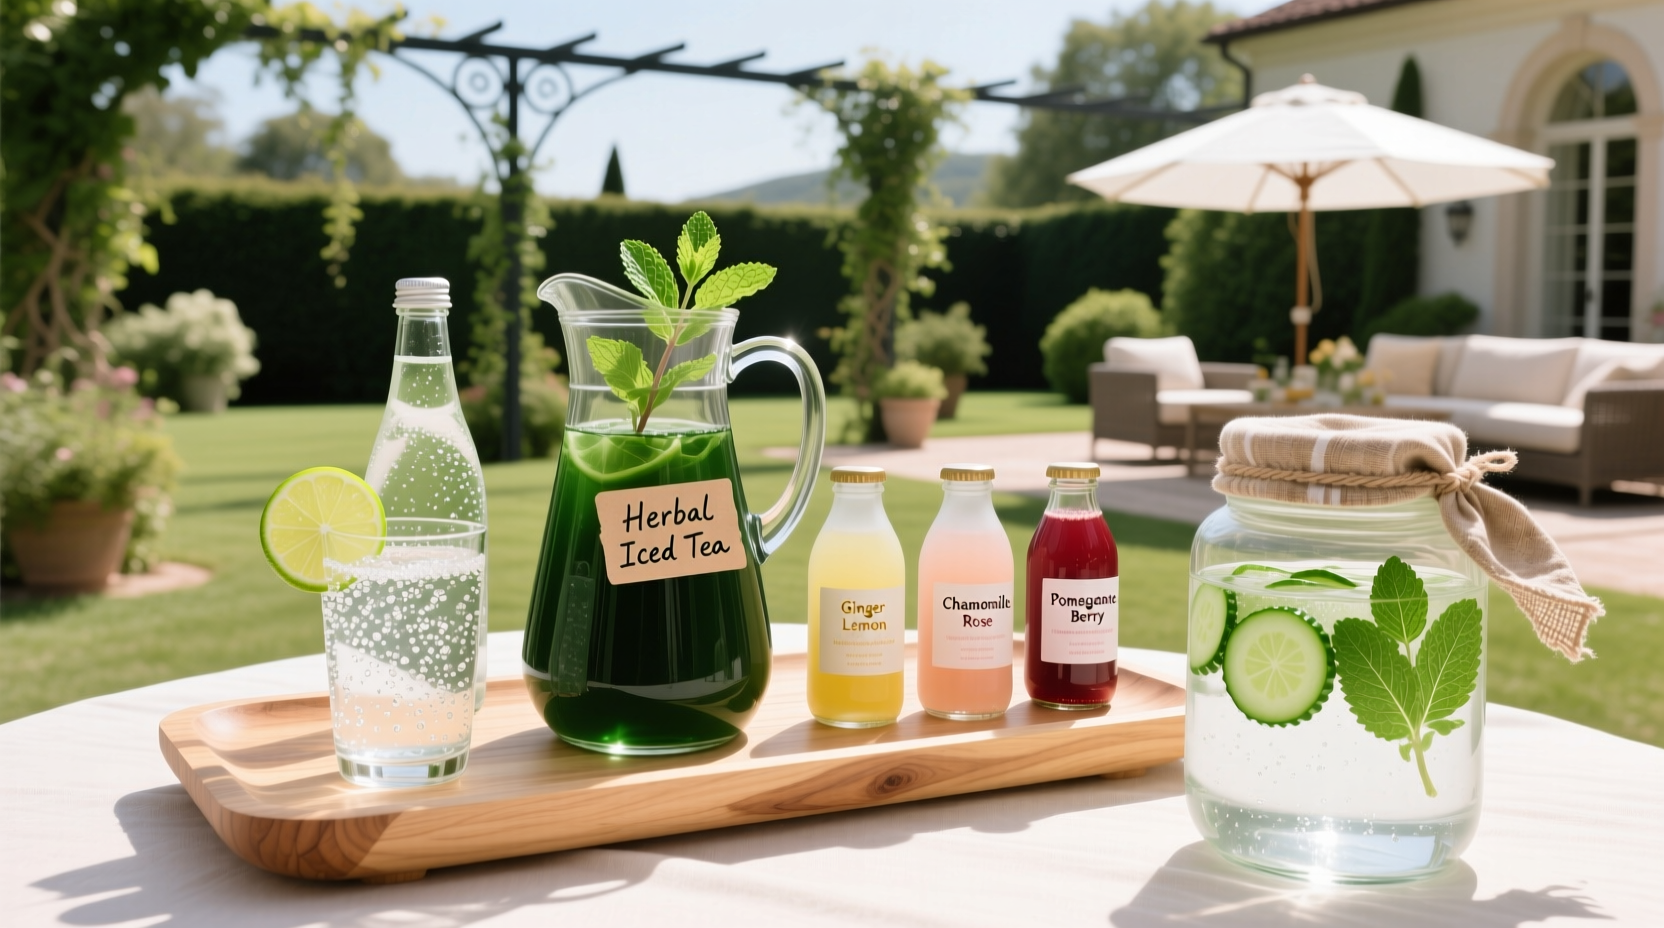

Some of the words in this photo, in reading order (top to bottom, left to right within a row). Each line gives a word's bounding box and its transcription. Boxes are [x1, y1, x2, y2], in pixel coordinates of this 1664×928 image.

[622, 493, 714, 533] Herbal
[619, 534, 677, 569] Iced
[683, 531, 731, 559] Tea
[841, 600, 886, 618] Ginger
[1071, 609, 1105, 626] Berry
[842, 617, 887, 631] Lemon
[962, 614, 993, 628] Rose
